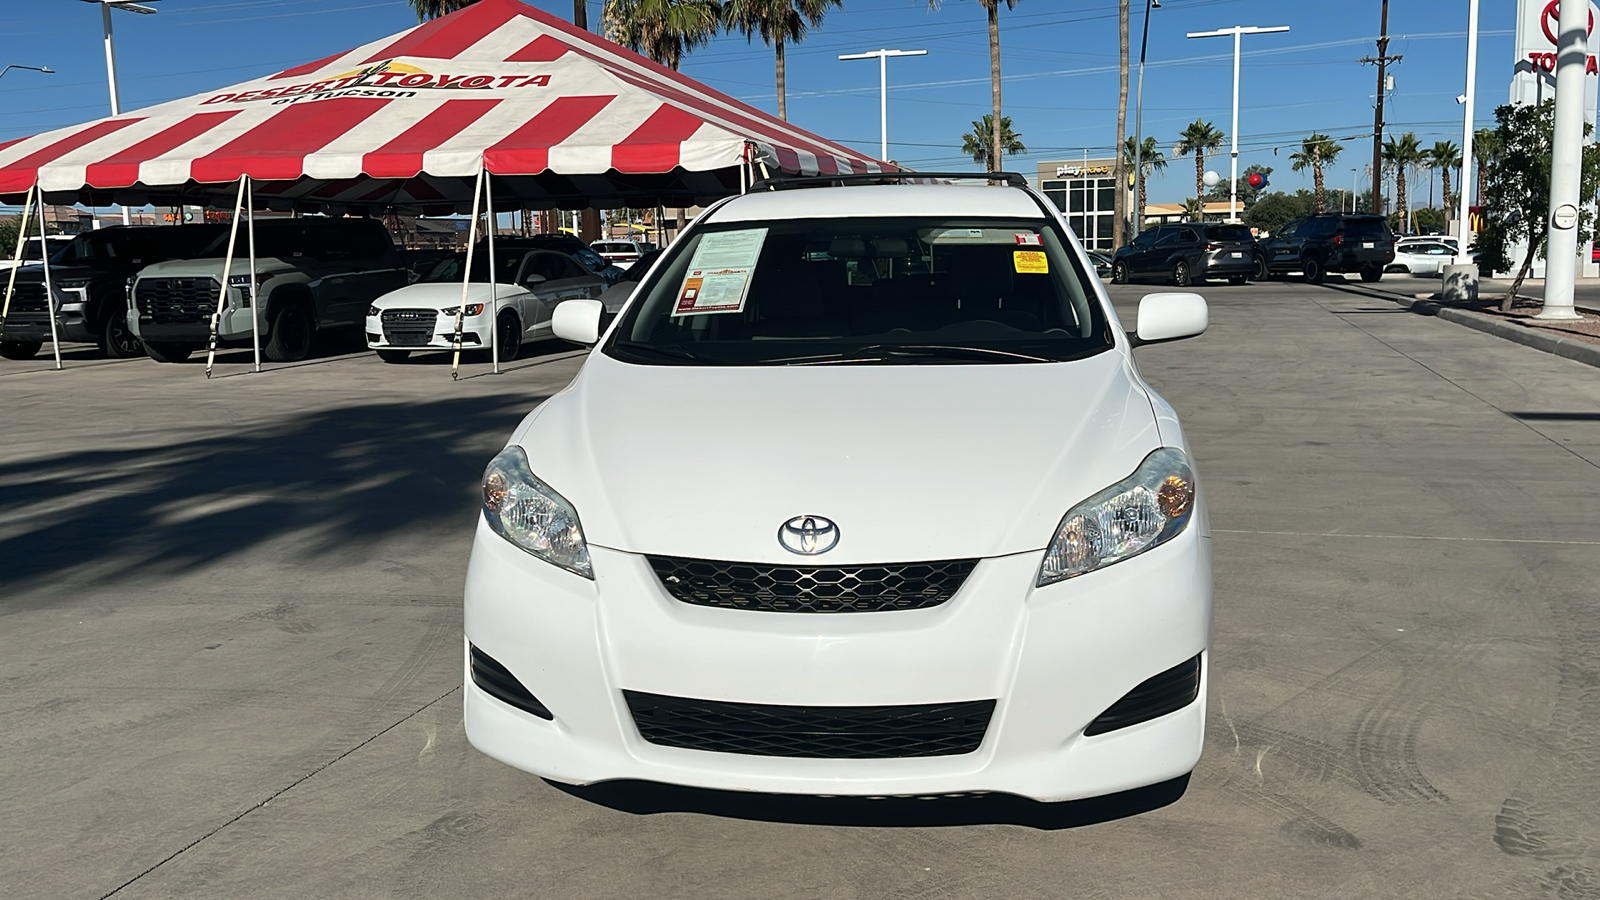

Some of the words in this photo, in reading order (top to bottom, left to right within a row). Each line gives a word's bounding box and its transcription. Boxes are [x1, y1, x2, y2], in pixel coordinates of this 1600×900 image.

[1528, 52, 1598, 76] TOA
[198, 75, 363, 105] DESERT
[373, 71, 552, 88] TOYOTA
[271, 95, 306, 105] of
[311, 89, 417, 100] Tucson
